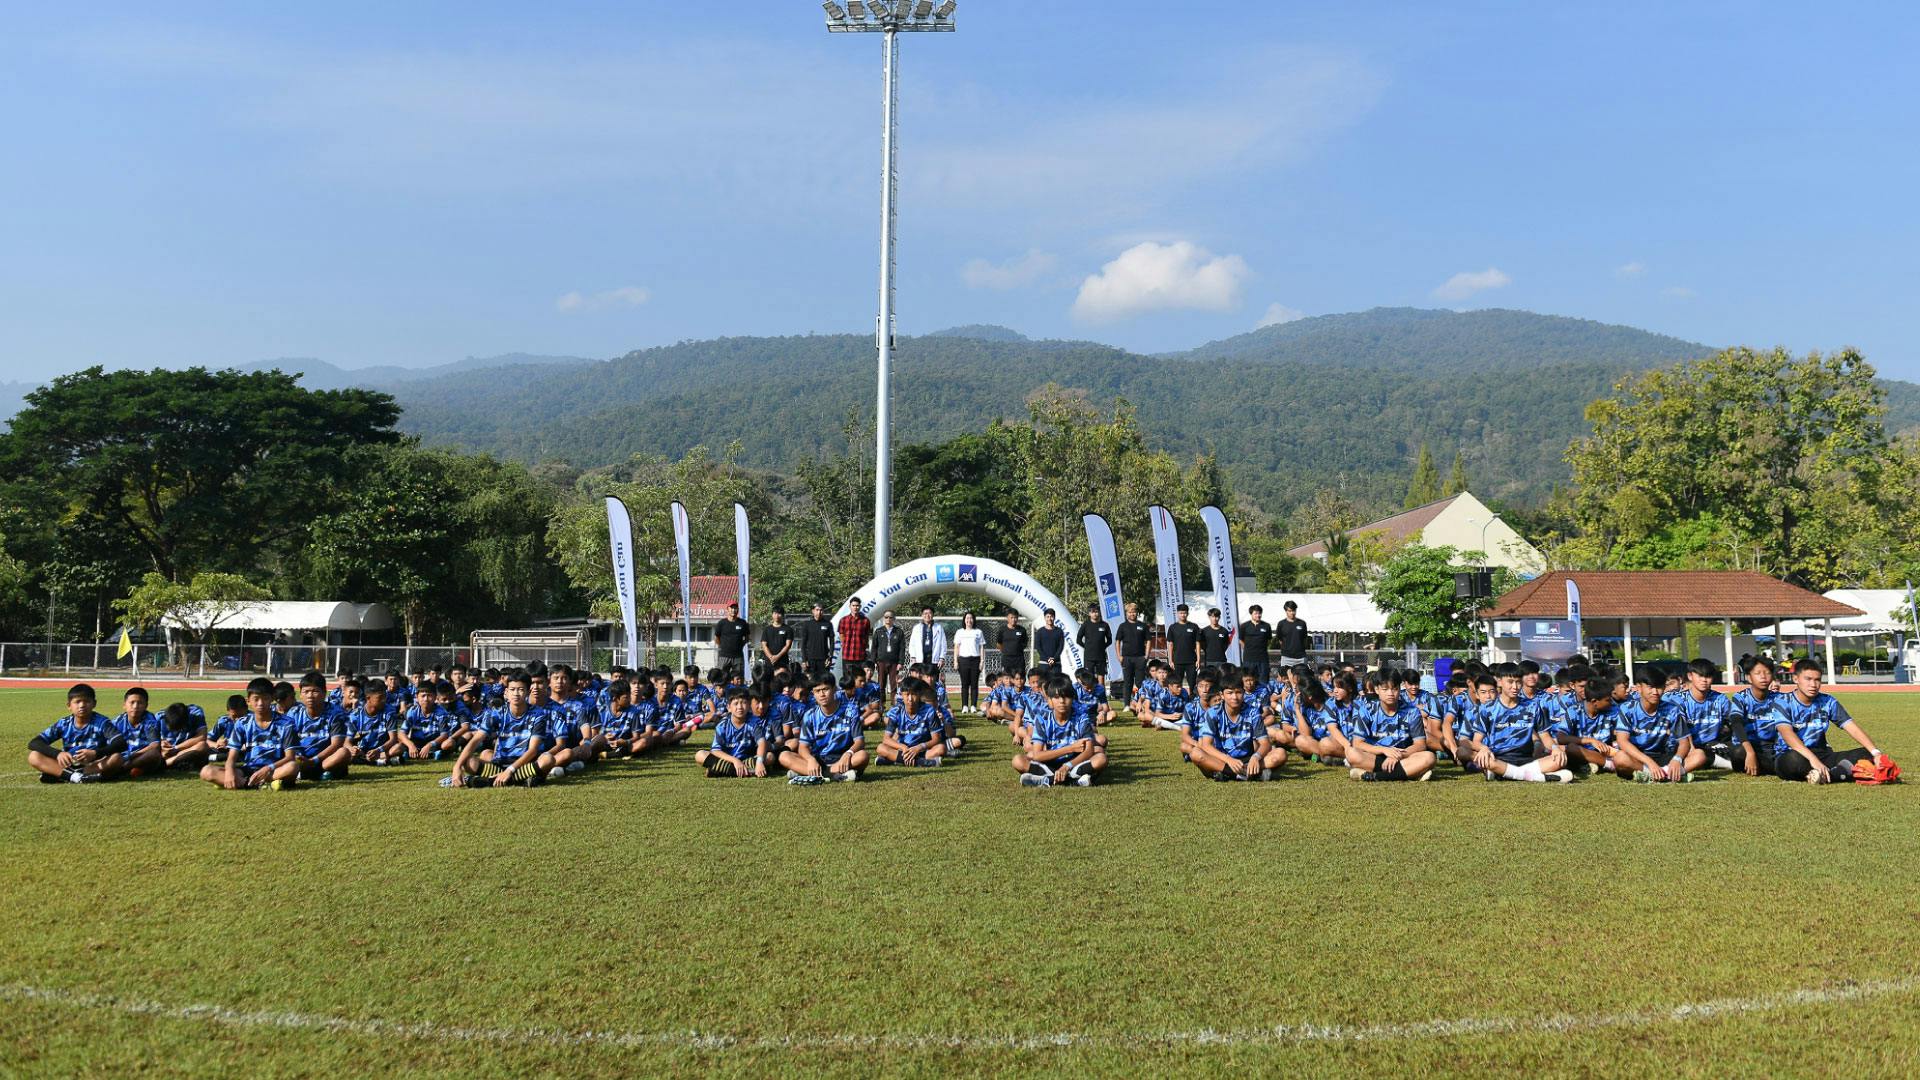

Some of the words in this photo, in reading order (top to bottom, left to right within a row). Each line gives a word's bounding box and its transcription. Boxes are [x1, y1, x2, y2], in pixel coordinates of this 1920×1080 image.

[879, 583, 901, 599] You
[904, 572, 928, 586] Can
[959, 572, 974, 581] AXA
[983, 573, 1023, 594] Football
[1023, 589, 1047, 612] Youth
[1063, 631, 1083, 669] Academ
